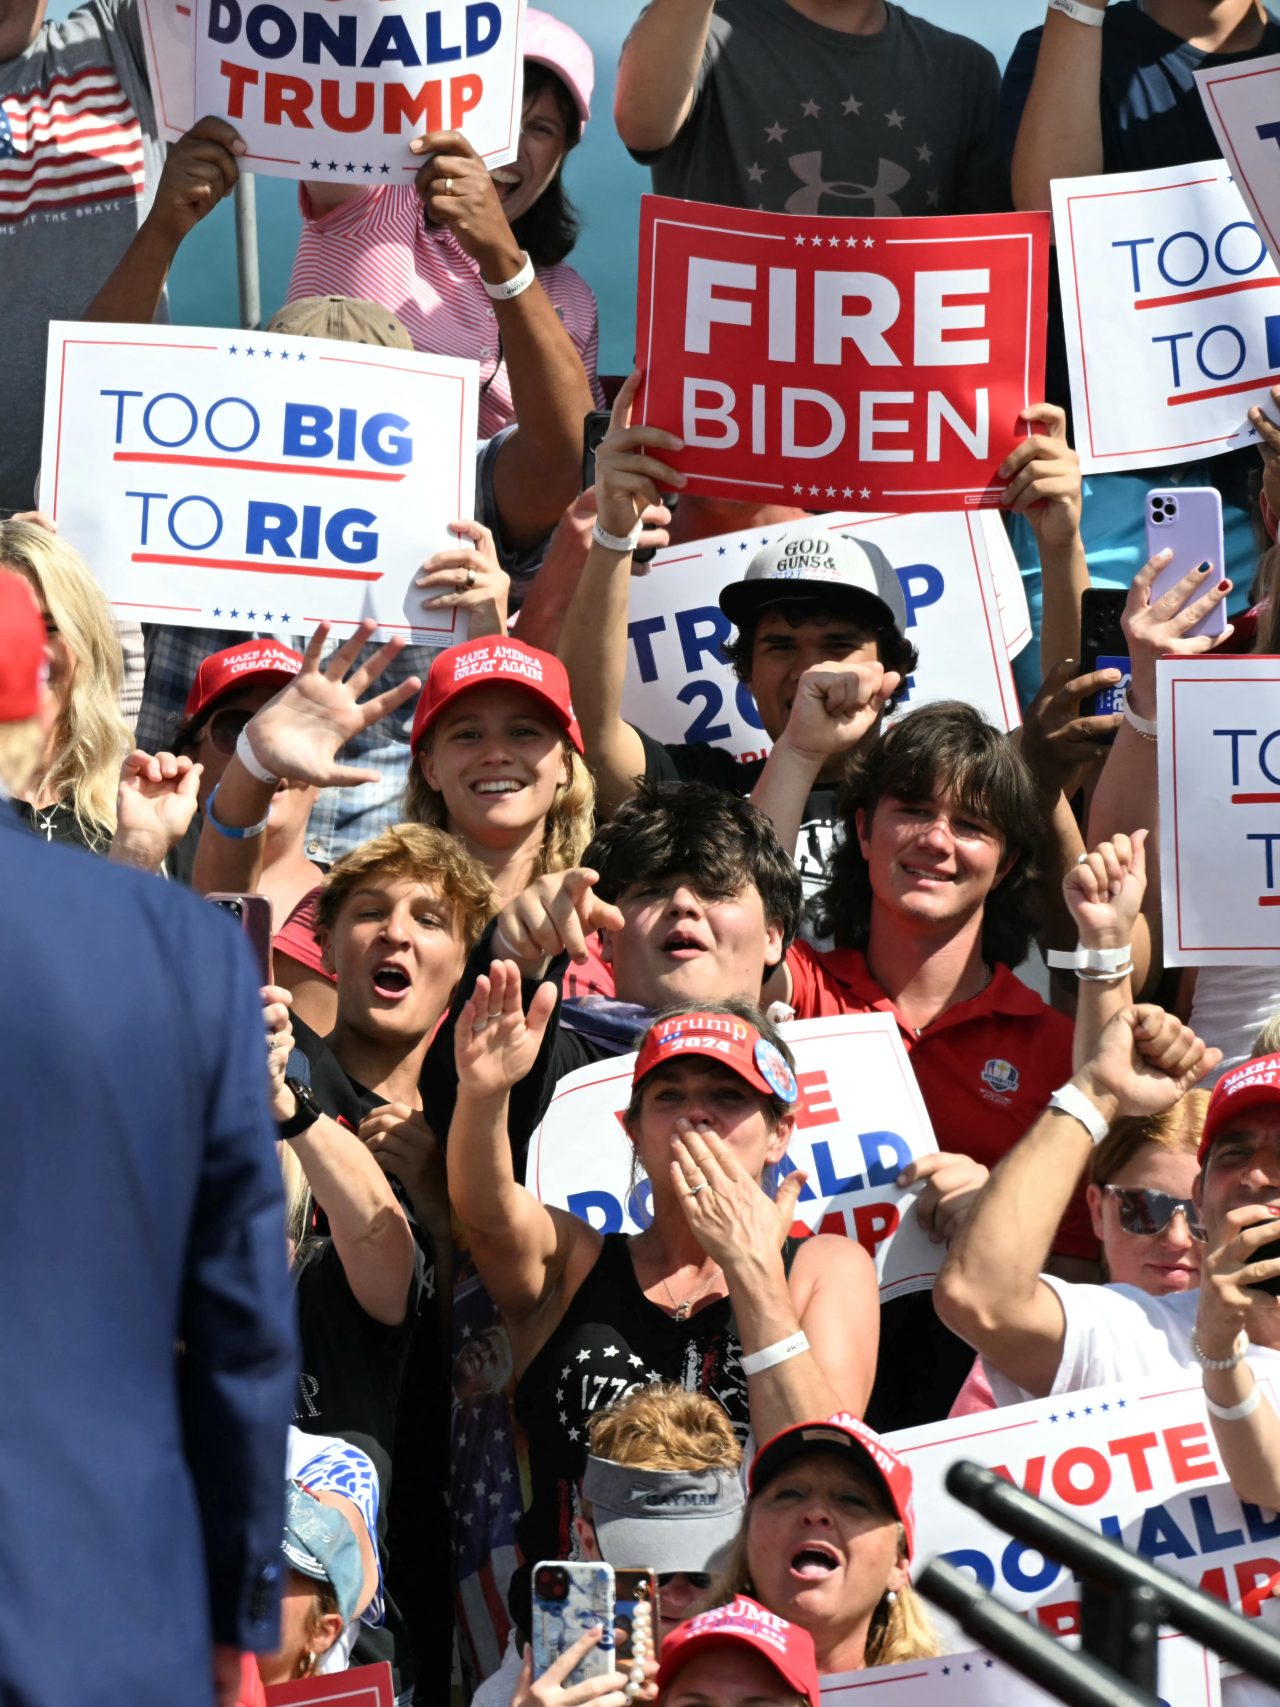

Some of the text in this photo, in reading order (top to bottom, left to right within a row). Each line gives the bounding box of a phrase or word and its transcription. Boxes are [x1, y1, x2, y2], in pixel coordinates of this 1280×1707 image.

[207, 1, 502, 69] DONALD
[221, 60, 483, 135] TRUMP
[44, 212, 68, 222] THE
[75, 203, 121, 219] BRAVE
[1111, 220, 1267, 293] TOO
[684, 256, 990, 367] FIRE
[1152, 324, 1247, 388] TO
[100, 389, 413, 466] TOO BIG
[683, 376, 989, 463] BIDEN
[125, 491, 379, 564] TO RIG
[784, 538, 830, 557] GOD
[777, 555, 837, 572] GUNS &
[627, 563, 945, 683] TRP
[223, 650, 260, 667] MAKE
[231, 659, 272, 674] GREAT
[454, 659, 543, 682] GREAT AGAIN
[455, 646, 543, 670] MAKE AMERICA
[659, 1017, 748, 1042] Trump
[670, 1037, 731, 1053] 2024
[1227, 1071, 1276, 1096] GREAT
